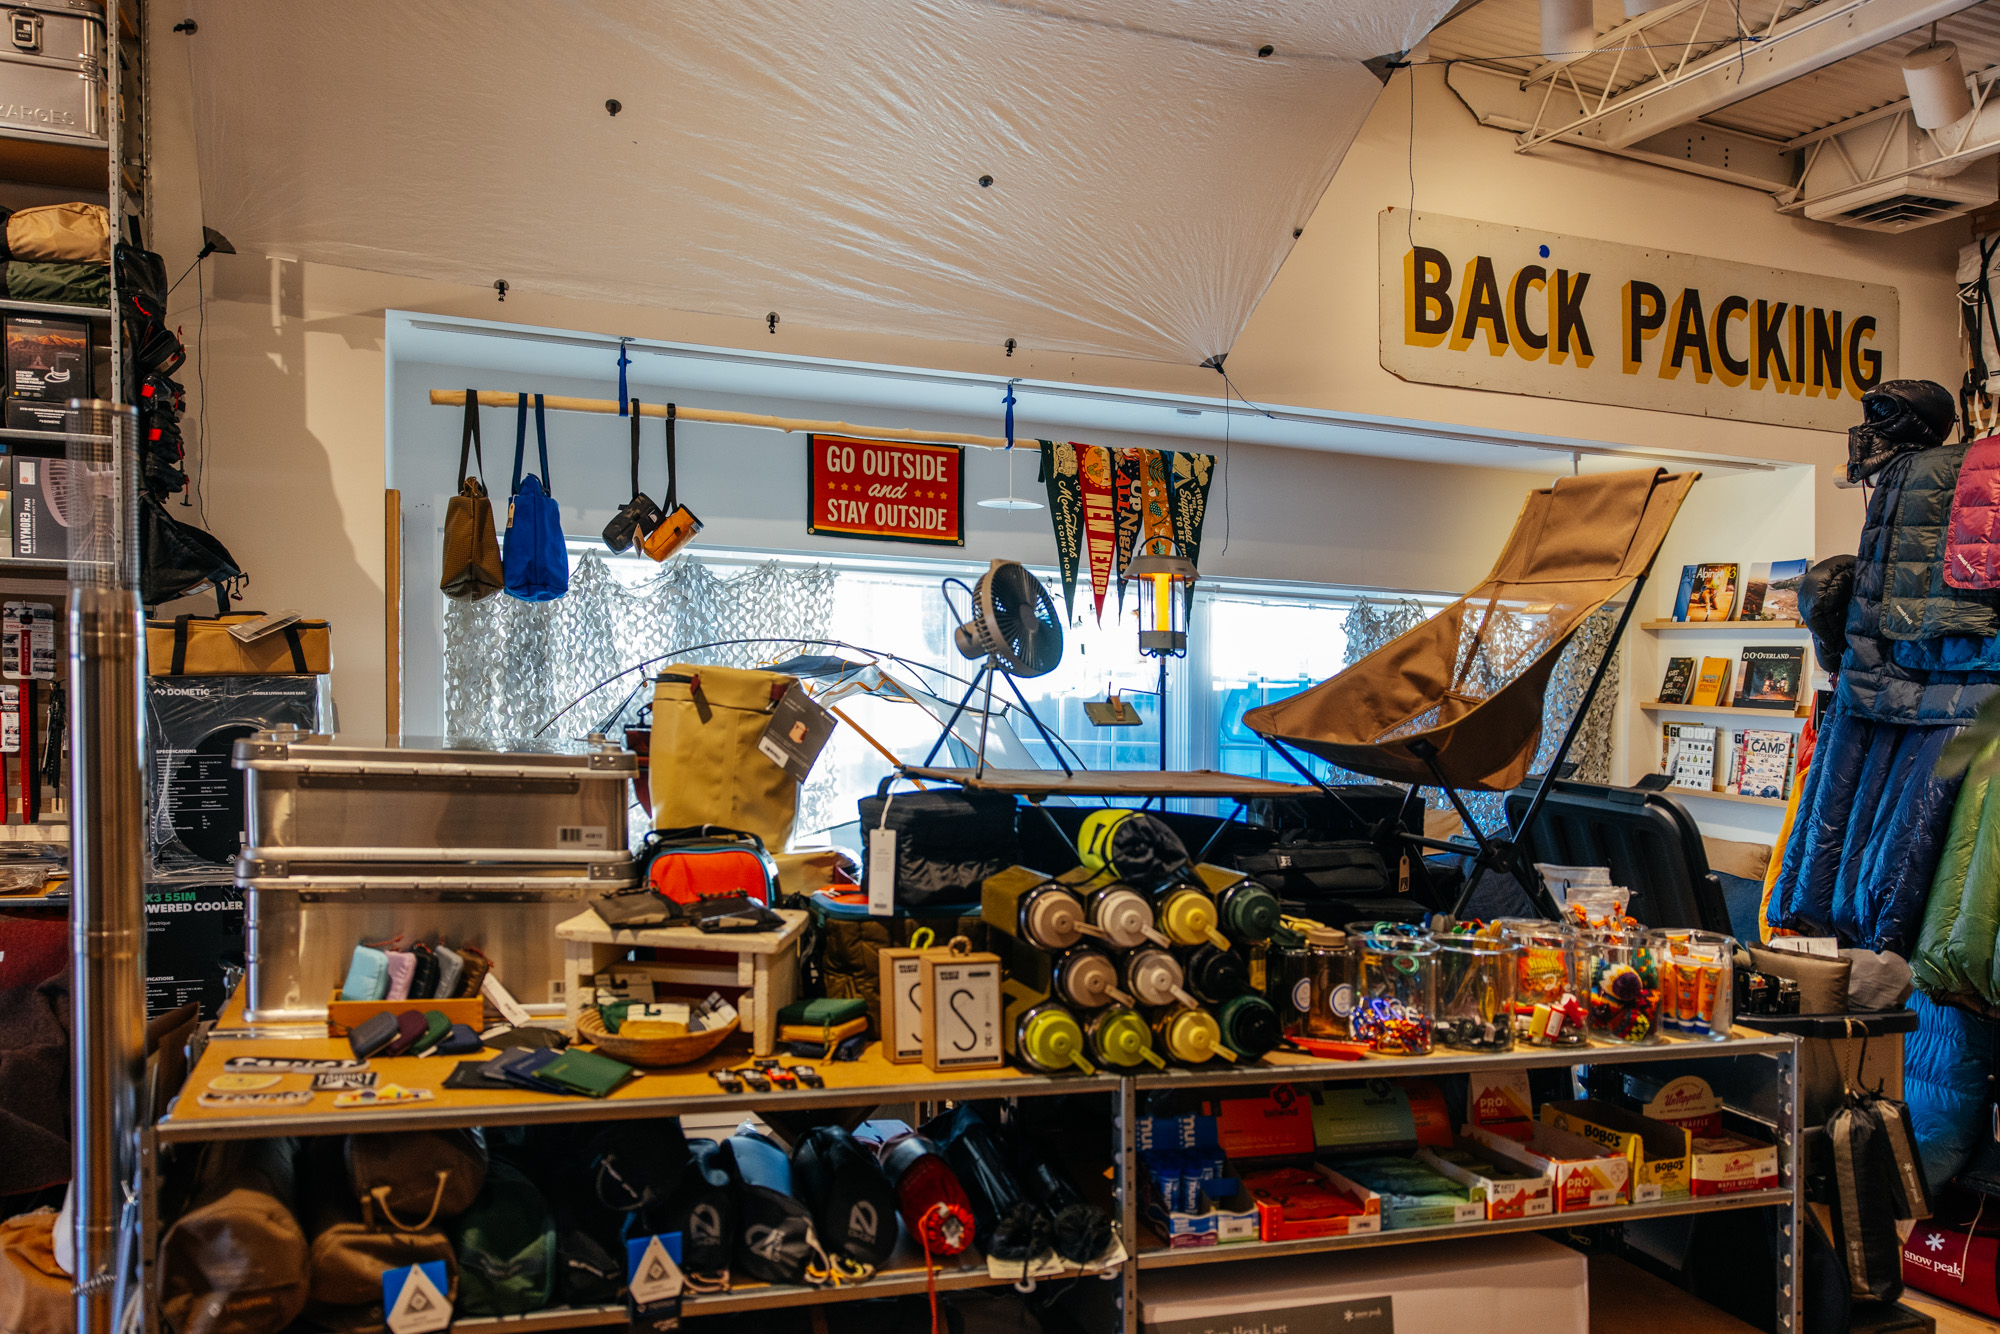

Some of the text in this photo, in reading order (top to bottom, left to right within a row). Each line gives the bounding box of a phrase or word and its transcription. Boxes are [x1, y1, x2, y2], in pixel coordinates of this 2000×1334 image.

[1403, 245, 1883, 401] BACK PACKING
[827, 445, 948, 483] GO OUTSIDE
[867, 481, 908, 499] and
[1115, 468, 1131, 513] ALL
[827, 499, 947, 532] STAY OUTSIDE
[1057, 480, 1078, 559] Mountains
[1179, 488, 1198, 546] Supposed
[1193, 488, 1204, 528] THOUGHT
[1176, 516, 1183, 528] TO
[1055, 512, 1073, 583] IS GOING HOME
[1085, 492, 1116, 596] NEW MEXICO
[1725, 566, 1737, 579] 83
[167, 688, 210, 696] DOMETIC
[1751, 741, 1786, 754] CAMP
[194, 901, 244, 911] COOLER
[1480, 1098, 1503, 1107] PRO
[1583, 1124, 1623, 1148] BOBO'S
[1654, 1160, 1685, 1174] BOBO'S
[1567, 1177, 1590, 1187] PRO
[1903, 1250, 1962, 1276] snow peak
